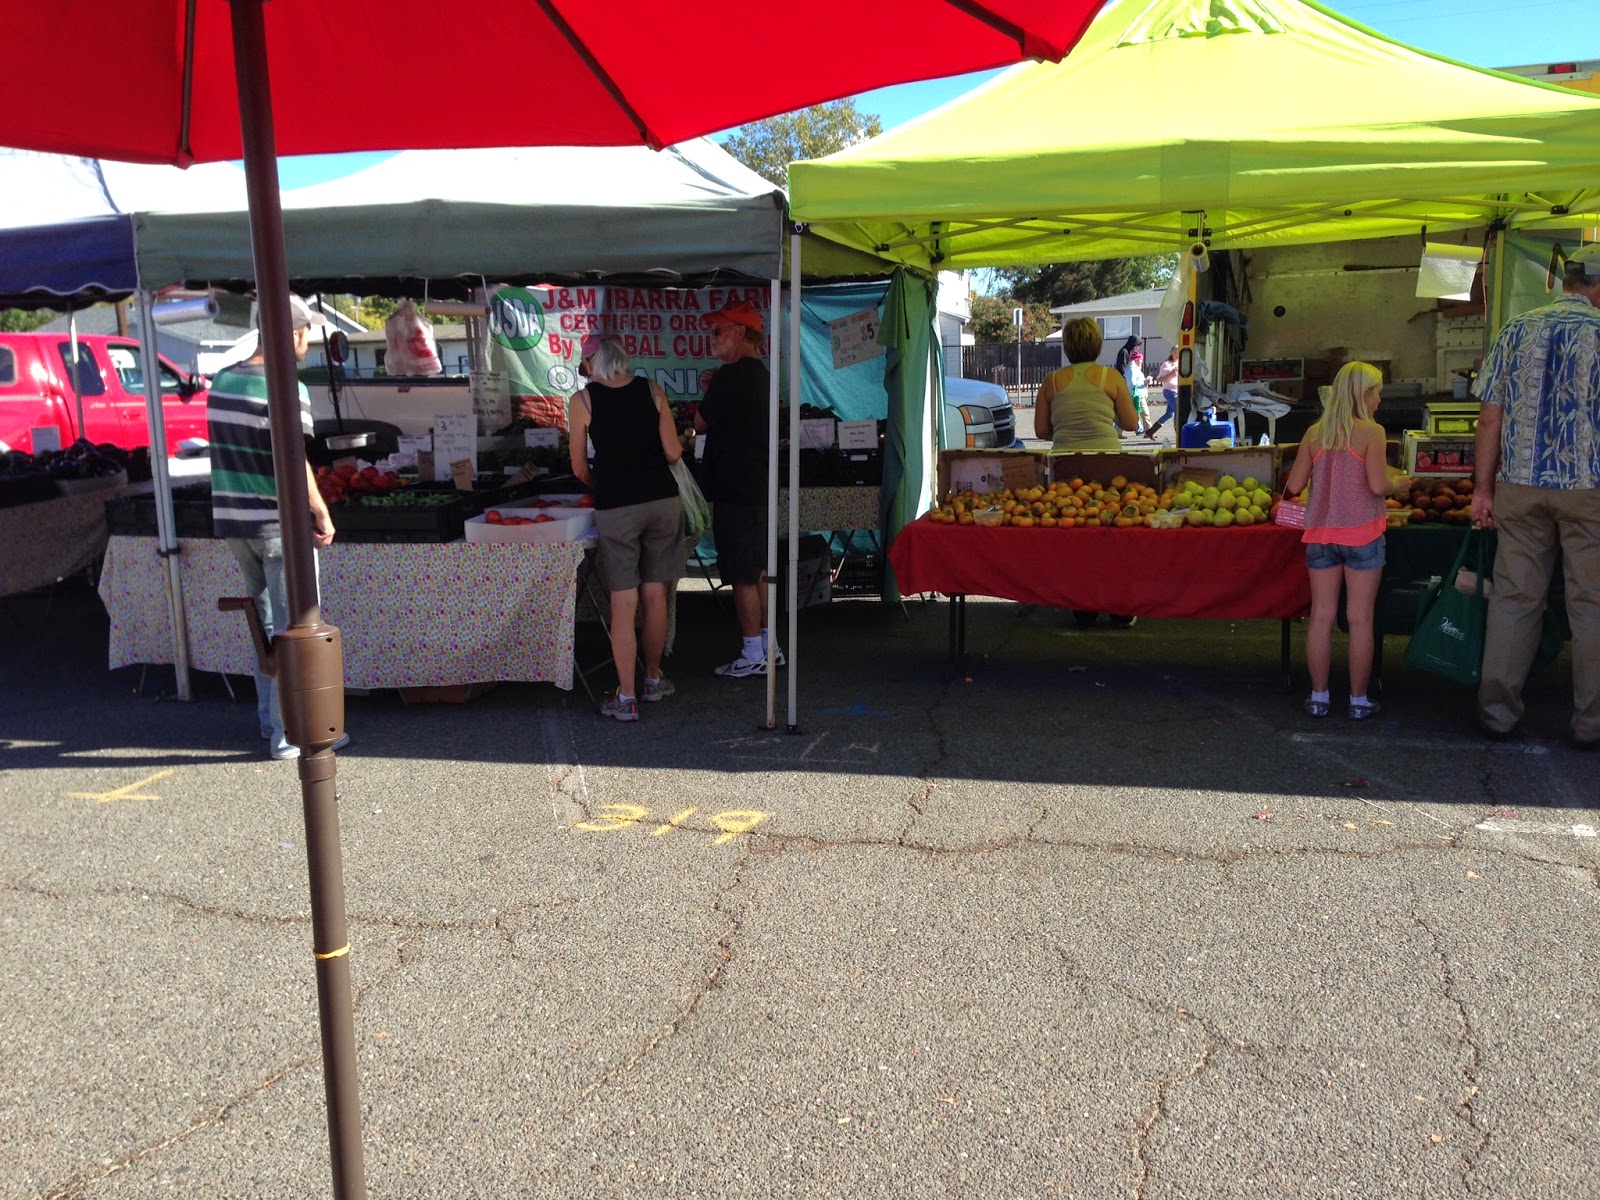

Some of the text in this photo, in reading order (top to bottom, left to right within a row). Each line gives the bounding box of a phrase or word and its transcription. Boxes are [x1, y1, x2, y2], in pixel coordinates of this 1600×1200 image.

[542, 288, 597, 310] J&M
[606, 287, 699, 311] IBARRA
[490, 297, 542, 338] USDA
[560, 313, 663, 331] CERTIFIED
[548, 333, 574, 361] By
